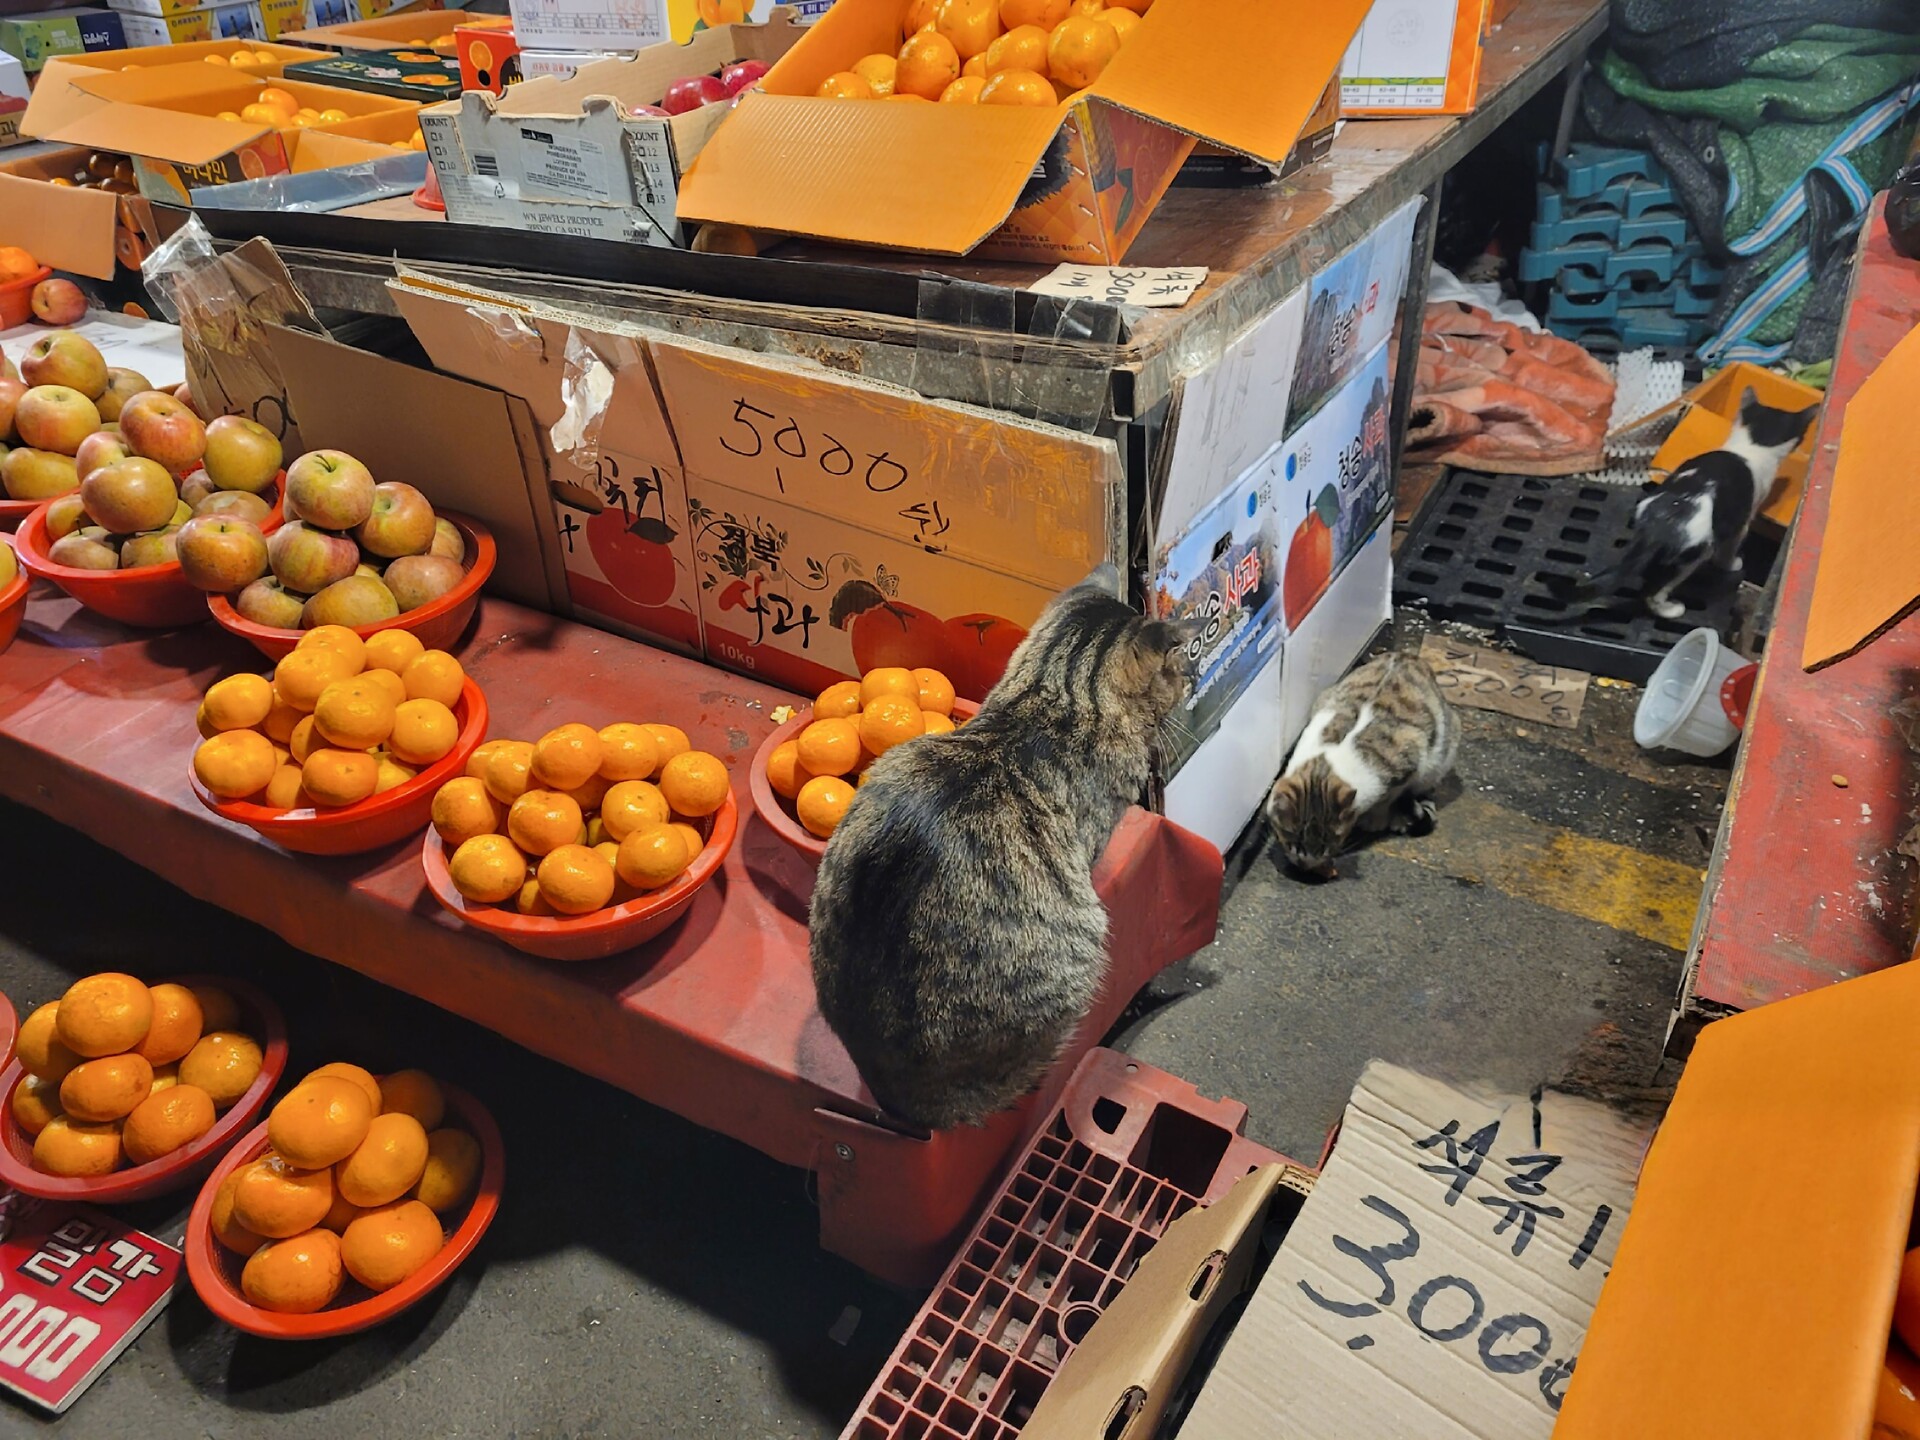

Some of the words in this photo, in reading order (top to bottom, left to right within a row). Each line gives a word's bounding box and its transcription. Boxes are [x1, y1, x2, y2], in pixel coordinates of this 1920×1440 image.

[646, 147, 659, 156] 12
[649, 163, 660, 173] 13
[653, 179, 664, 189] 14
[655, 195, 666, 204] 15
[1338, 435, 1363, 492] 청송
[1222, 546, 1262, 616] 사과
[719, 573, 821, 650] 사과
[718, 641, 756, 671] 10kg
[16, 1218, 164, 1307] 밀감
